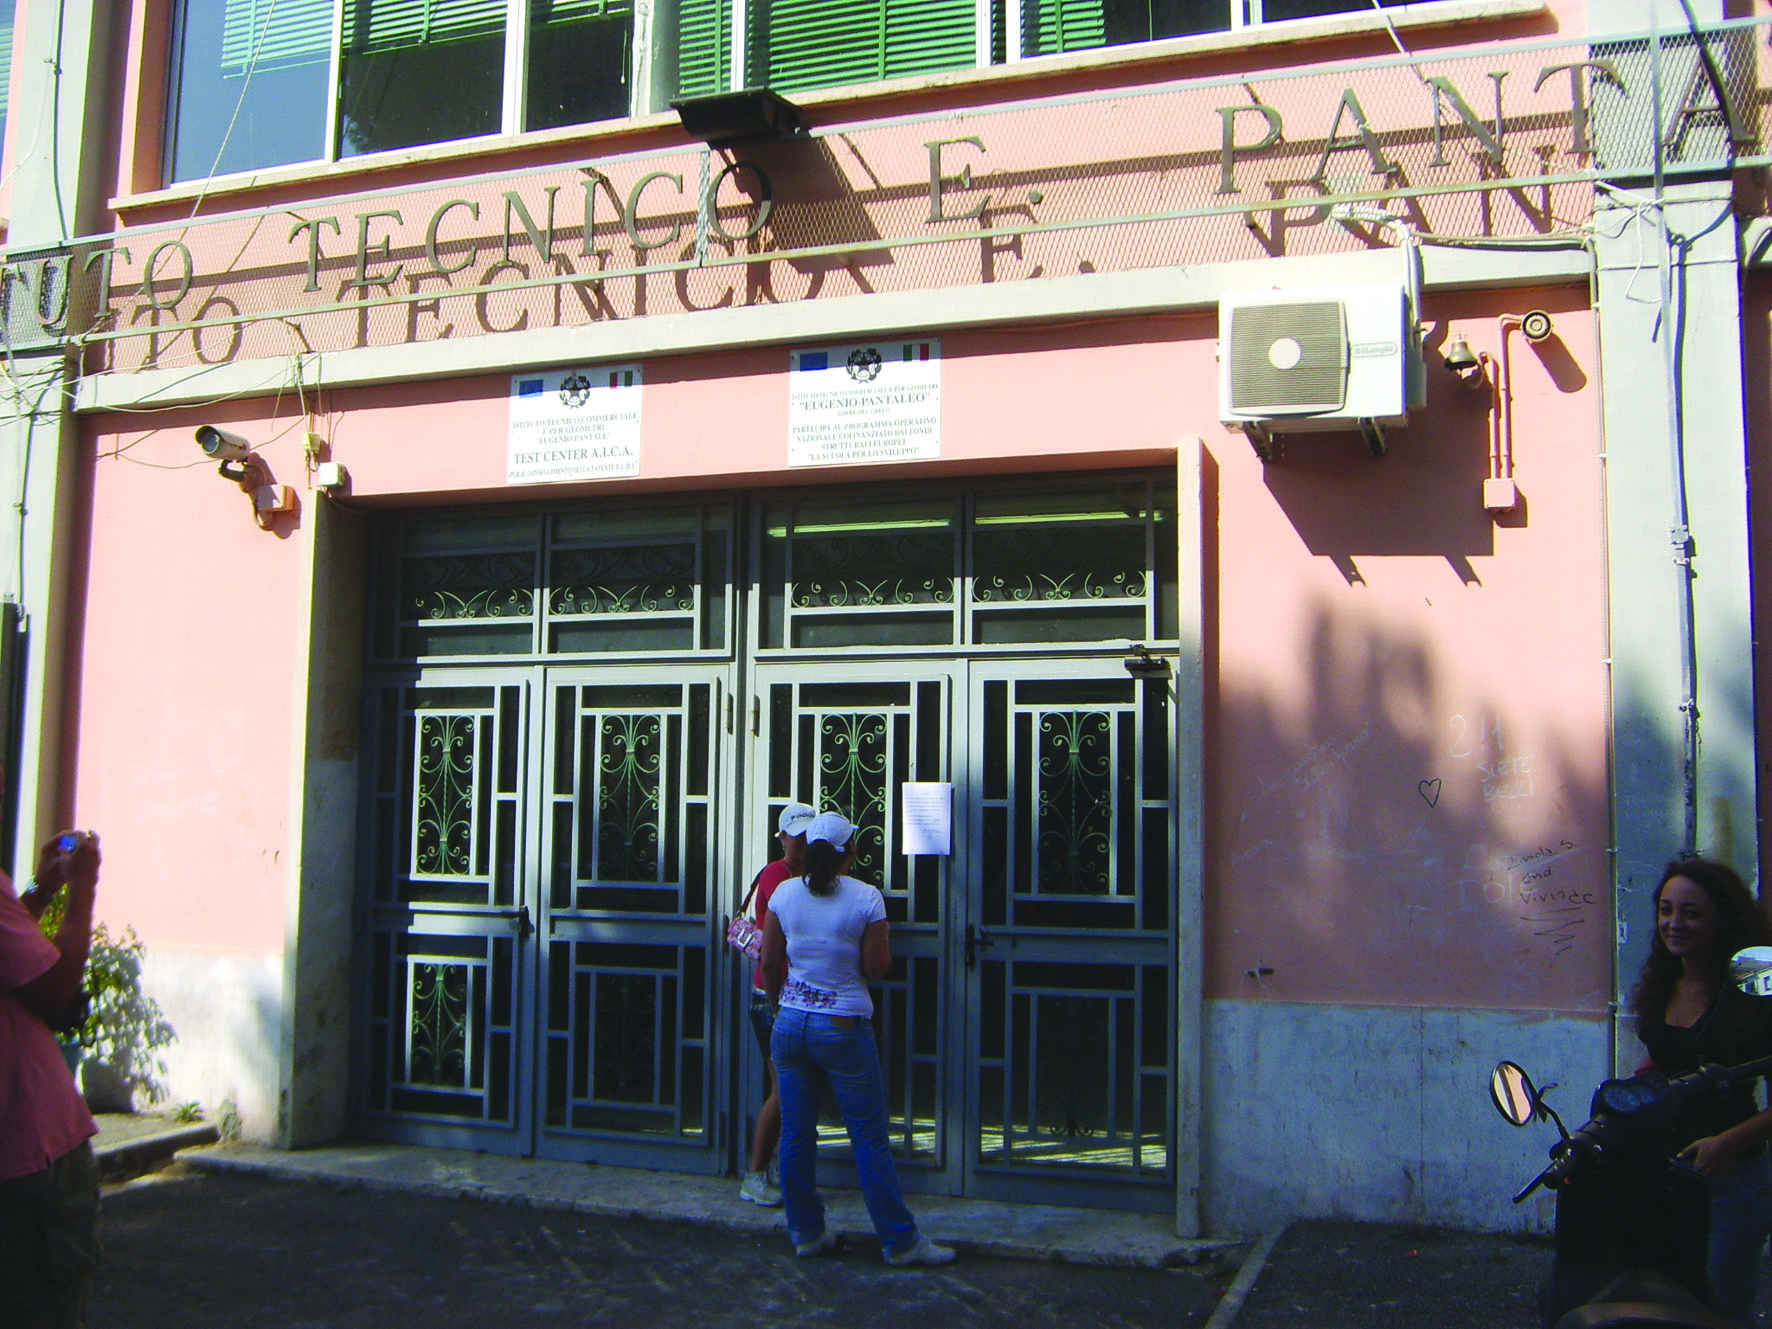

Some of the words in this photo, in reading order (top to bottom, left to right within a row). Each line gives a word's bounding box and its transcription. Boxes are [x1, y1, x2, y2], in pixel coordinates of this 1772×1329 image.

[288, 160, 774, 292] TECNICO
[924, 136, 1043, 224] E.
[1214, 55, 1756, 194] PANTA
[549, 426, 563, 435] PER
[792, 424, 830, 434] PARTECIPA
[844, 420, 892, 431] PROGRAMMA
[894, 416, 937, 427] OPERATIVO
[796, 432, 837, 443] NAZIONALE
[838, 428, 893, 440] COFINANZIATO
[909, 426, 933, 436] FONDI
[514, 452, 541, 464] TEST
[543, 449, 588, 462] CENTER
[591, 445, 633, 459] A.I.C.A.
[852, 449, 866, 459] PER
